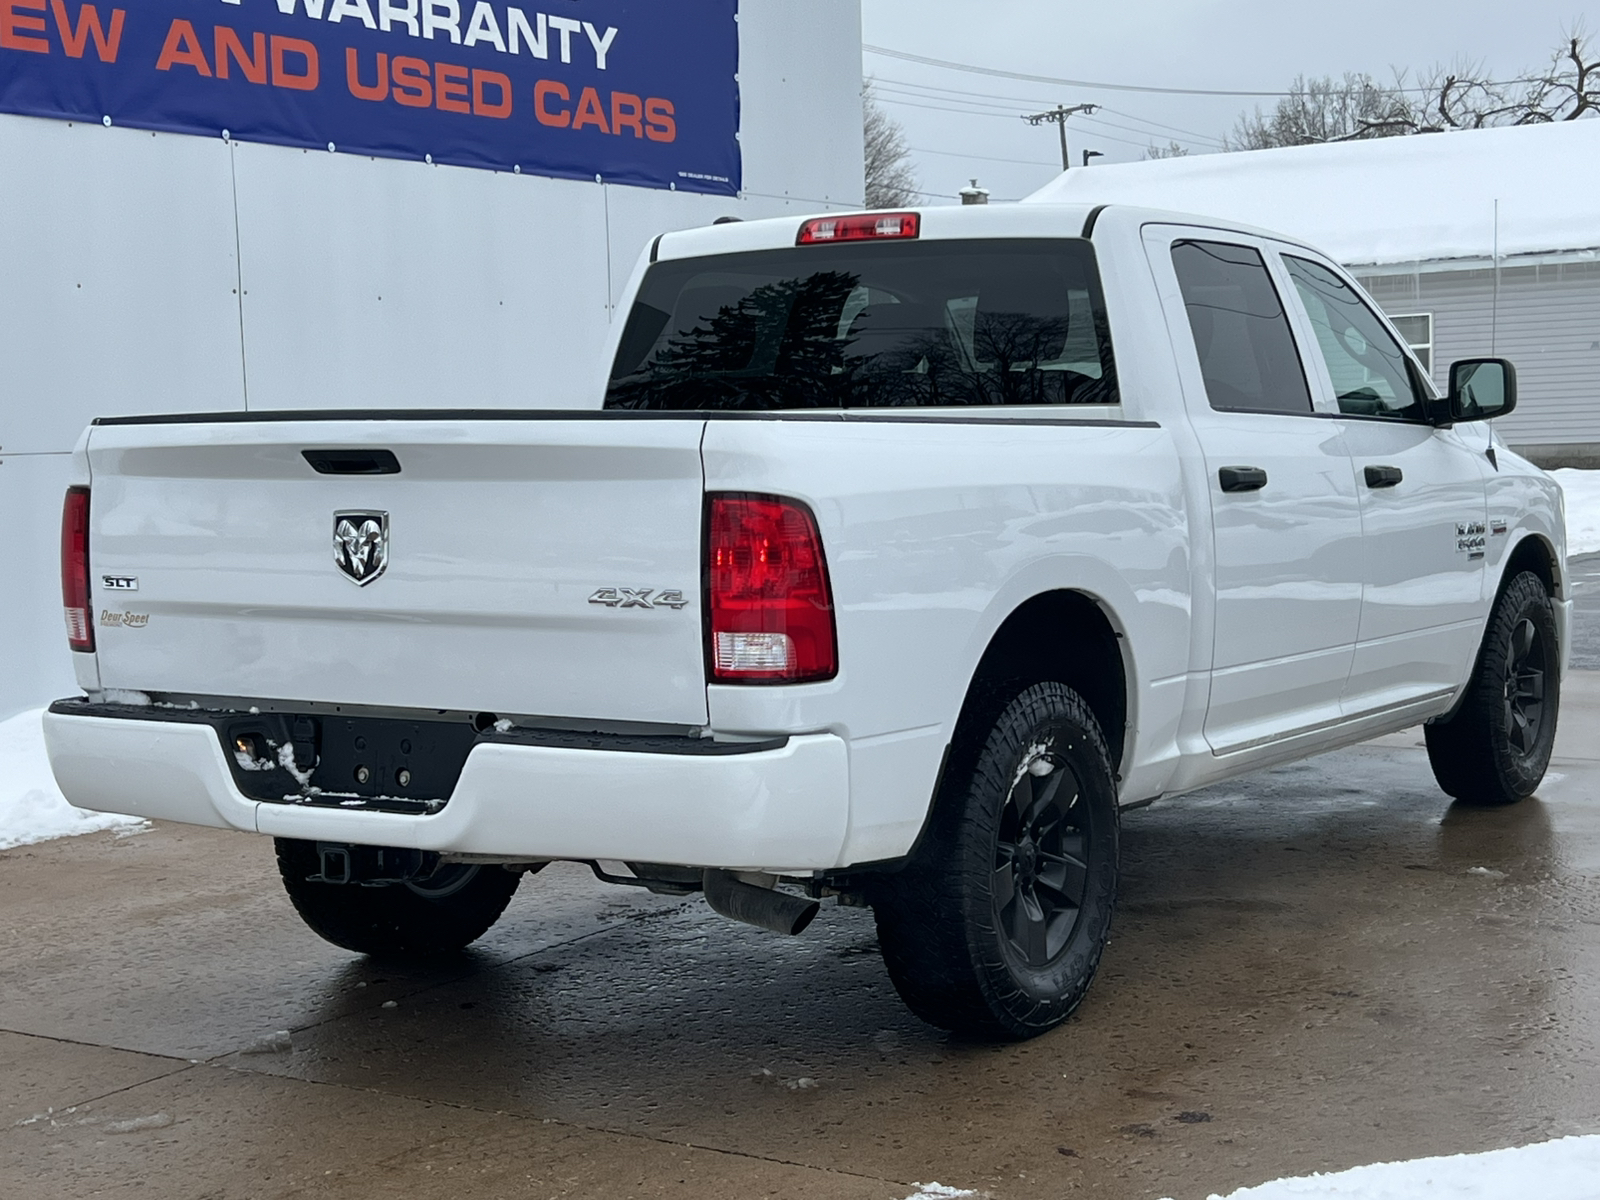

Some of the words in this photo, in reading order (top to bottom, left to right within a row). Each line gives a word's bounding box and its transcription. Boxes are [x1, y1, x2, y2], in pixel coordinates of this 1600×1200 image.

[0, 0, 126, 63] EW
[155, 18, 320, 91] AND
[345, 47, 512, 119] USED
[533, 79, 677, 143] CARS
[103, 577, 136, 588] SLT
